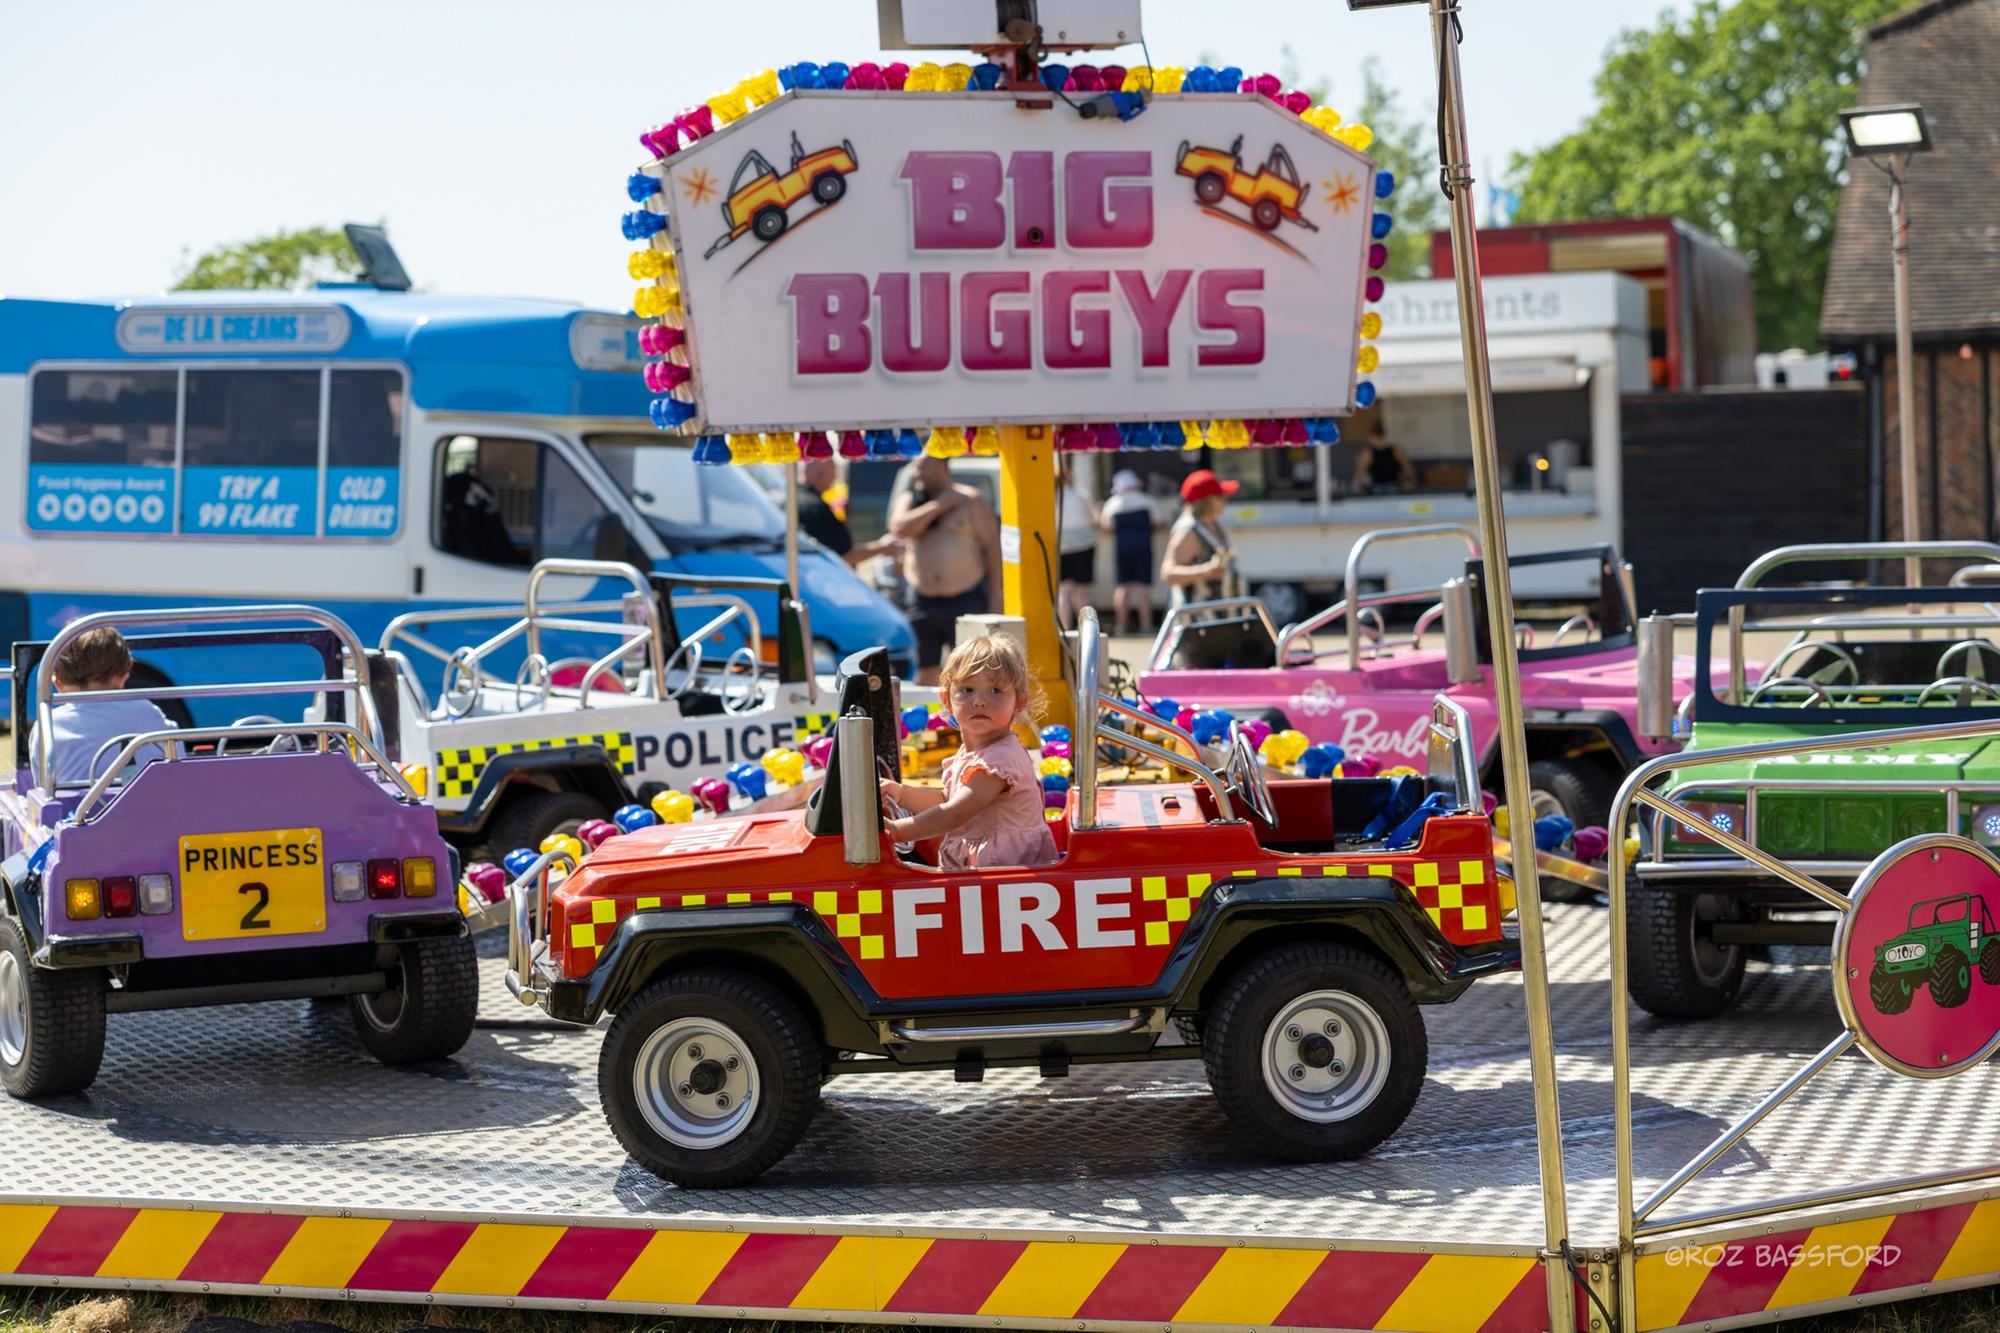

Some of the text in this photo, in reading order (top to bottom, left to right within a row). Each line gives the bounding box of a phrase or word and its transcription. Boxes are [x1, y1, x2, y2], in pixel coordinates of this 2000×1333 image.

[901, 150, 1154, 251] BIG
[787, 268, 1266, 376] BUGGYS
[1380, 288, 1561, 325] shmnts
[193, 315, 214, 342] LA
[219, 475, 280, 500] TRY A
[339, 476, 386, 501] COLD
[198, 502, 299, 528] 99 FLAKE
[328, 503, 395, 529] DRINKS
[635, 722, 794, 772] POLICE
[185, 843, 318, 872] PRINCESS
[238, 882, 271, 930] 2
[892, 877, 1136, 959] FIRE
